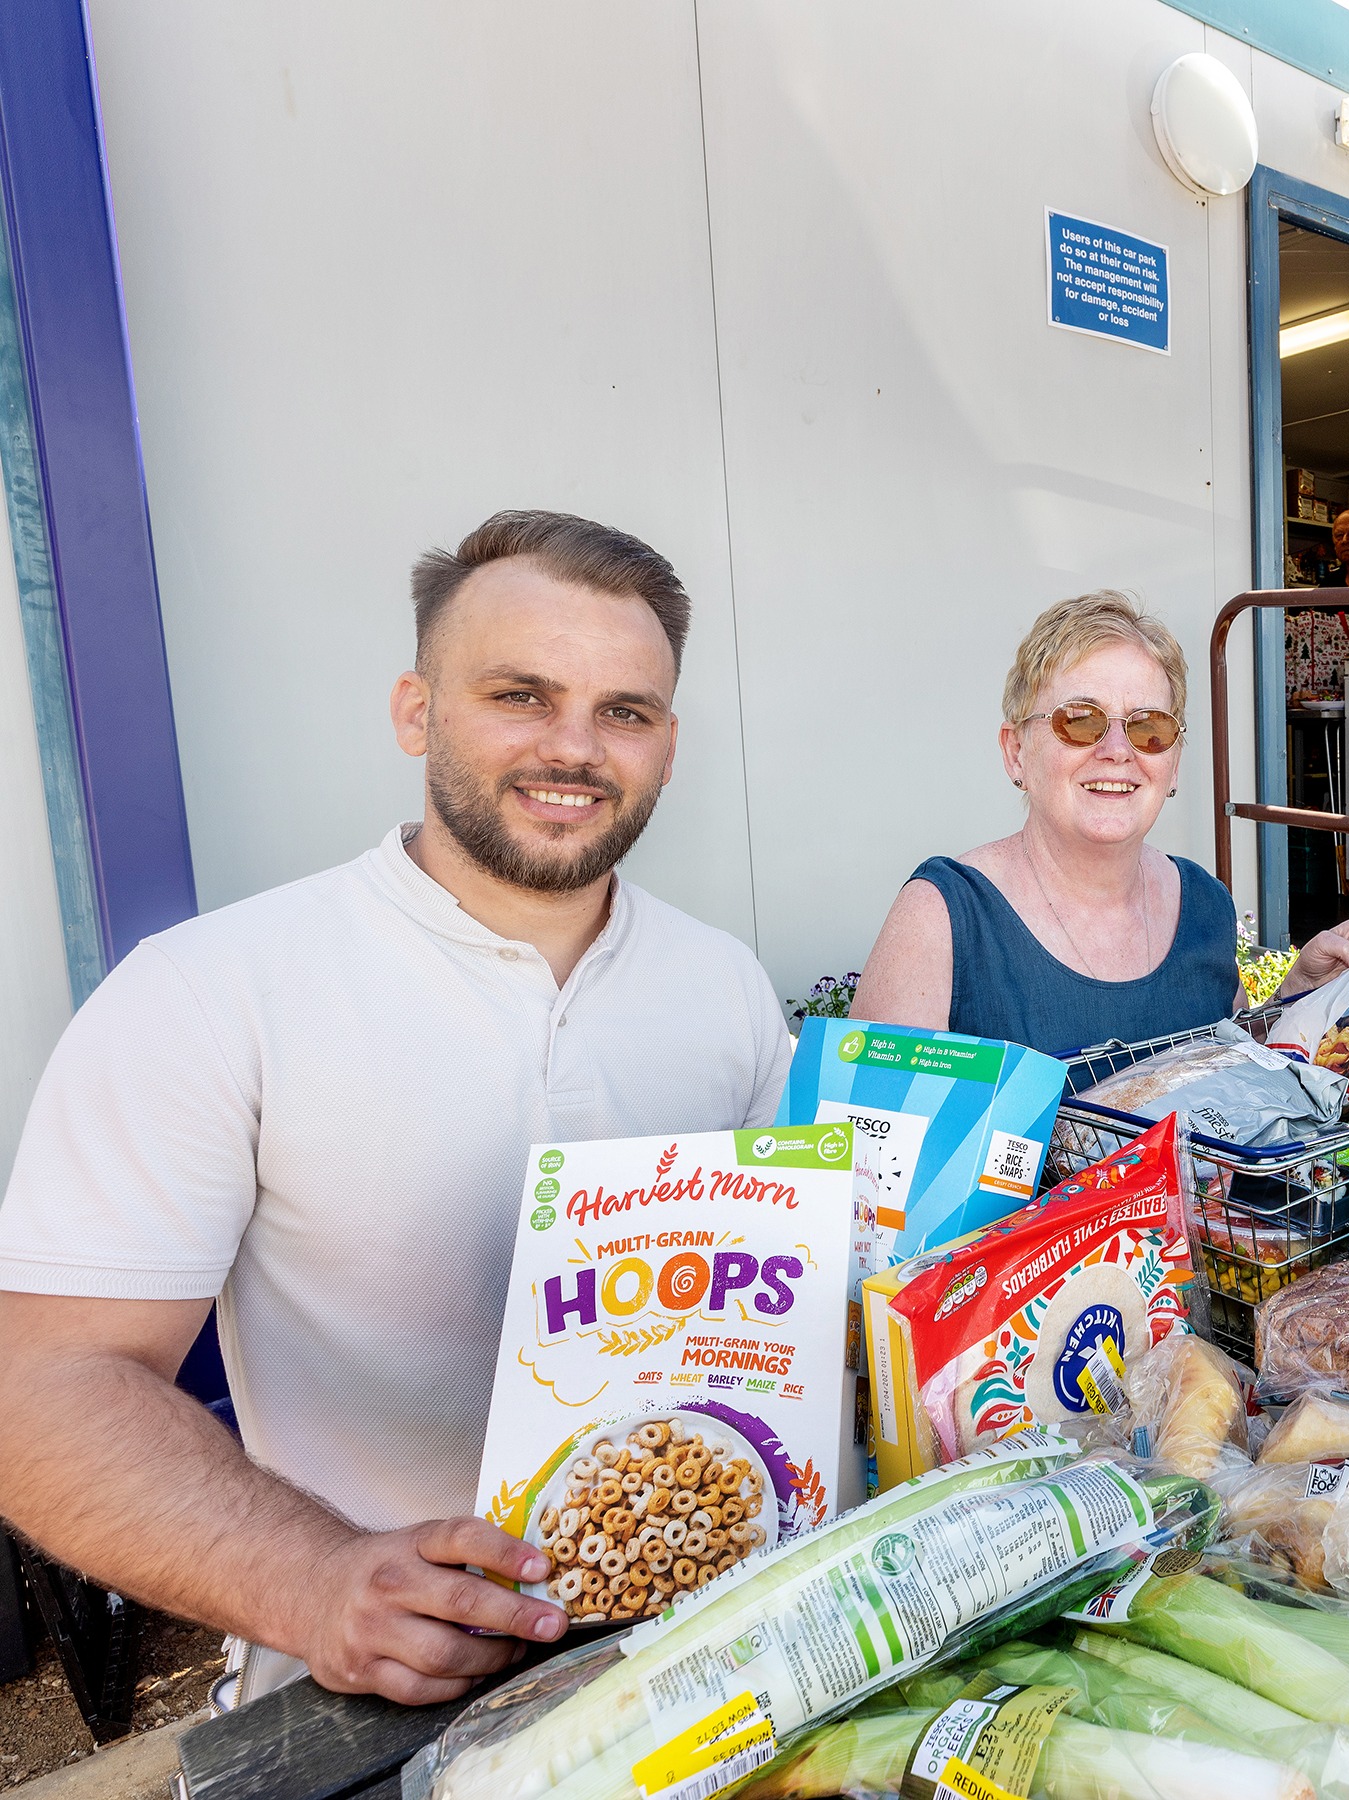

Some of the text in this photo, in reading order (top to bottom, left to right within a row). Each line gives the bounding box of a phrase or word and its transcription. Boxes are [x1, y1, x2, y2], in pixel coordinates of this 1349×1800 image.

[1060, 243, 1159, 281] do so at their own risk.
[1062, 228, 1156, 267] Users of this car park
[1057, 272, 1164, 312] not accept responsibility
[1064, 258, 1157, 294] The management will
[1065, 287, 1157, 321] for damage, accident
[1099, 312, 1129, 327] or loss
[867, 1050, 901, 1062] Vitamin D
[871, 1039, 896, 1050] High in
[923, 1046, 936, 1055] High
[918, 1058, 931, 1068] High
[847, 1114, 891, 1134] TESCO
[1214, 1112, 1229, 1127] TESCO
[1006, 1154, 1023, 1167] RICE
[1008, 1140, 1028, 1150] TESCO
[999, 1164, 1023, 1179] SNAPS
[565, 1166, 706, 1227] Harvest
[709, 1169, 800, 1210] Morn
[854, 1201, 876, 1232] HOOPS
[1074, 1215, 1108, 1248] STYLE
[596, 1230, 715, 1260] MULTI-GRAIN
[1001, 1234, 1074, 1300] FLATBREADS
[544, 1251, 804, 1335] HOOPS
[685, 1336, 796, 1357] MULTI-GRAIN YOUR
[1062, 1310, 1117, 1362] KITCHEN
[681, 1348, 792, 1376] MORNINGS
[638, 1371, 805, 1395] OATS WHEAT BARLEY MAIZE RICE
[882, 1370, 890, 1411] 17/04/2027
[696, 1704, 751, 1745] NOW £0.72
[925, 1715, 950, 1748] TESCO
[927, 1703, 975, 1774] ORGANIC
[712, 1730, 769, 1763] NOW £0.33
